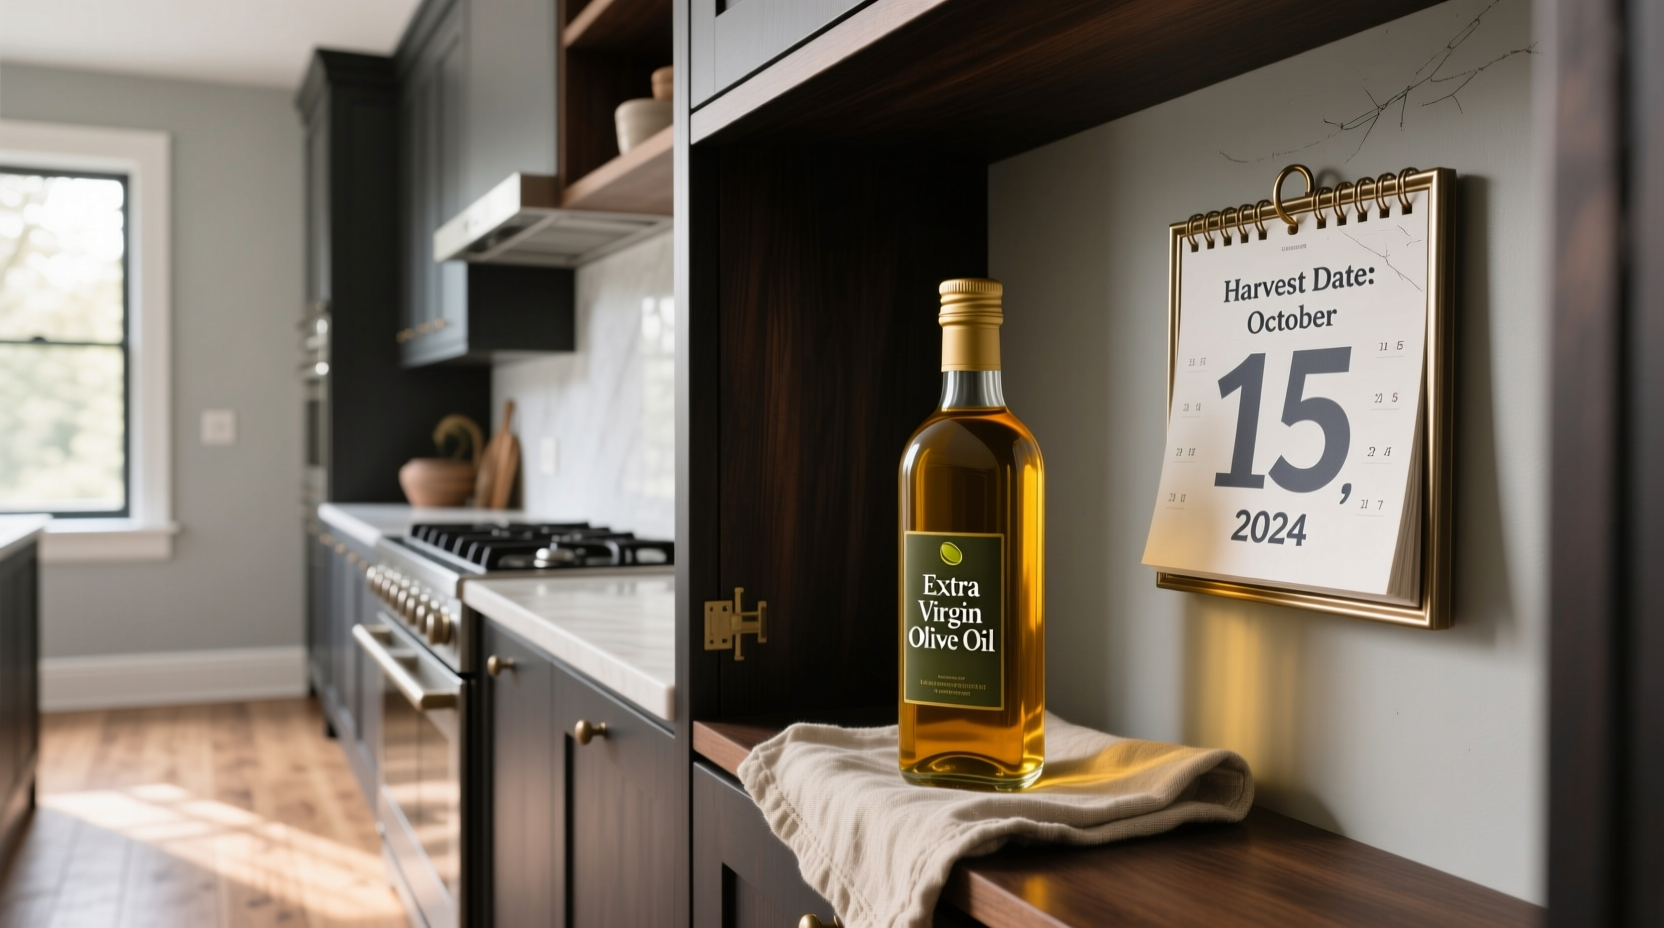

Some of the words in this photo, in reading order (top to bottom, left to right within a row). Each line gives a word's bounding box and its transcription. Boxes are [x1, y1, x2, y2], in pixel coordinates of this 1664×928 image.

[1223, 271, 1306, 303] Harvest
[1312, 264, 1375, 292] Date:
[1247, 304, 1338, 335] October
[1230, 509, 1307, 547] 2024
[922, 573, 981, 598] Extra
[917, 599, 983, 630] Virgin
[908, 625, 959, 651] Olive
[962, 628, 996, 653] Oil
